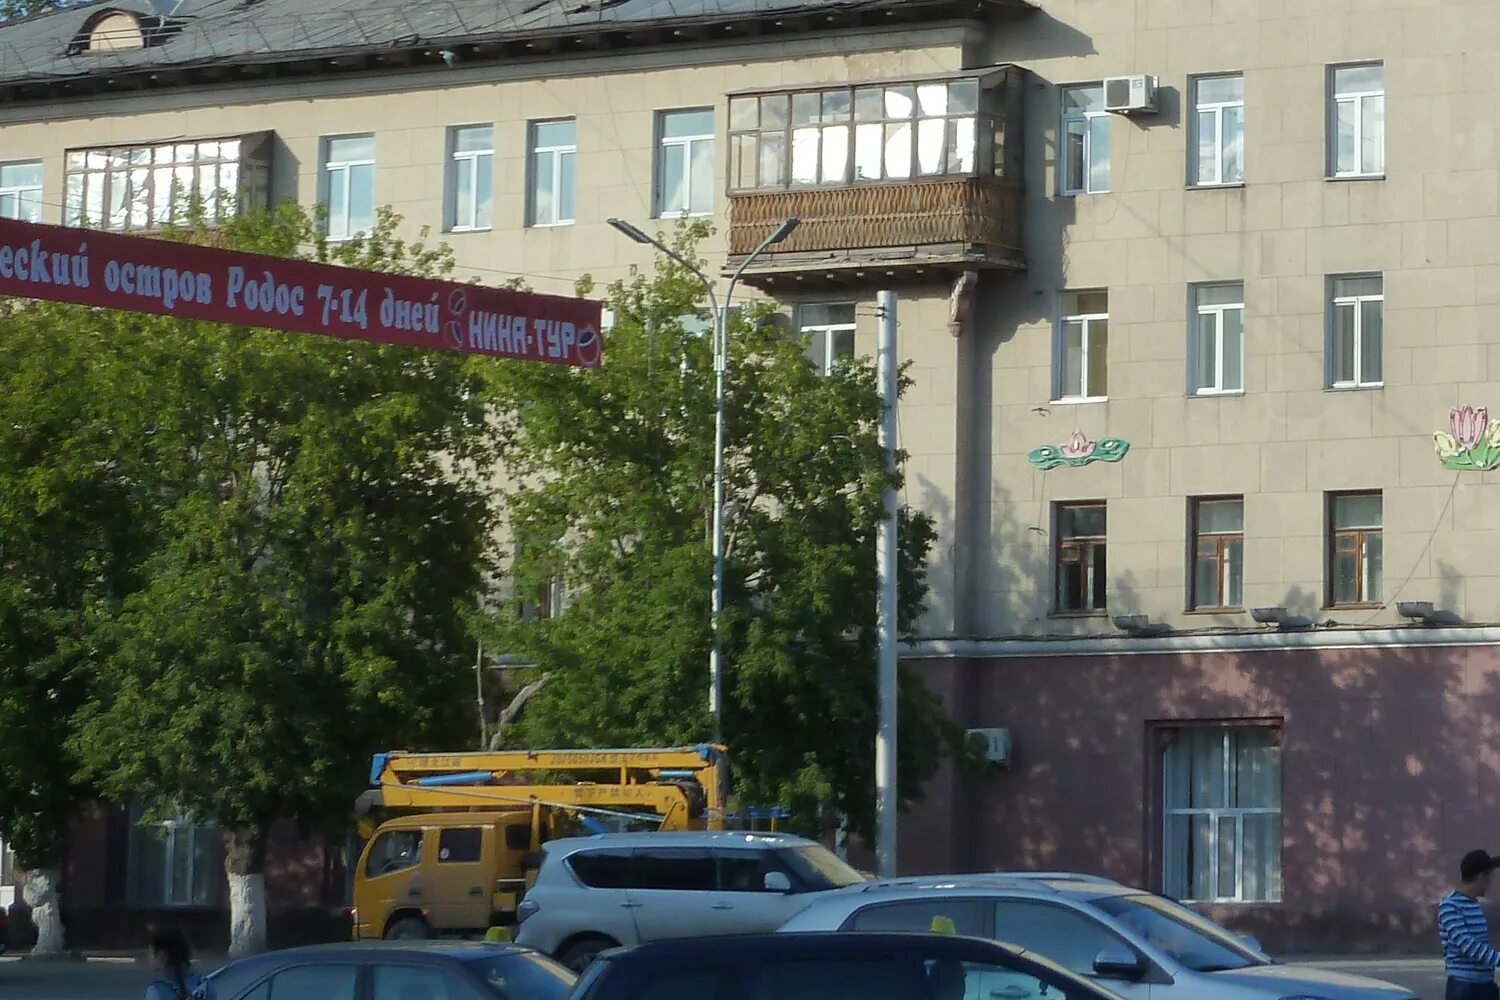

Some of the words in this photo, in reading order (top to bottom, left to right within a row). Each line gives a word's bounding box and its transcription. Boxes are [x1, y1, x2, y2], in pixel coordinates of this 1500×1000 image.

[104, 260, 212, 309] остров
[227, 266, 305, 316] Родос
[318, 284, 368, 329] 7-14
[379, 287, 440, 333] дней
